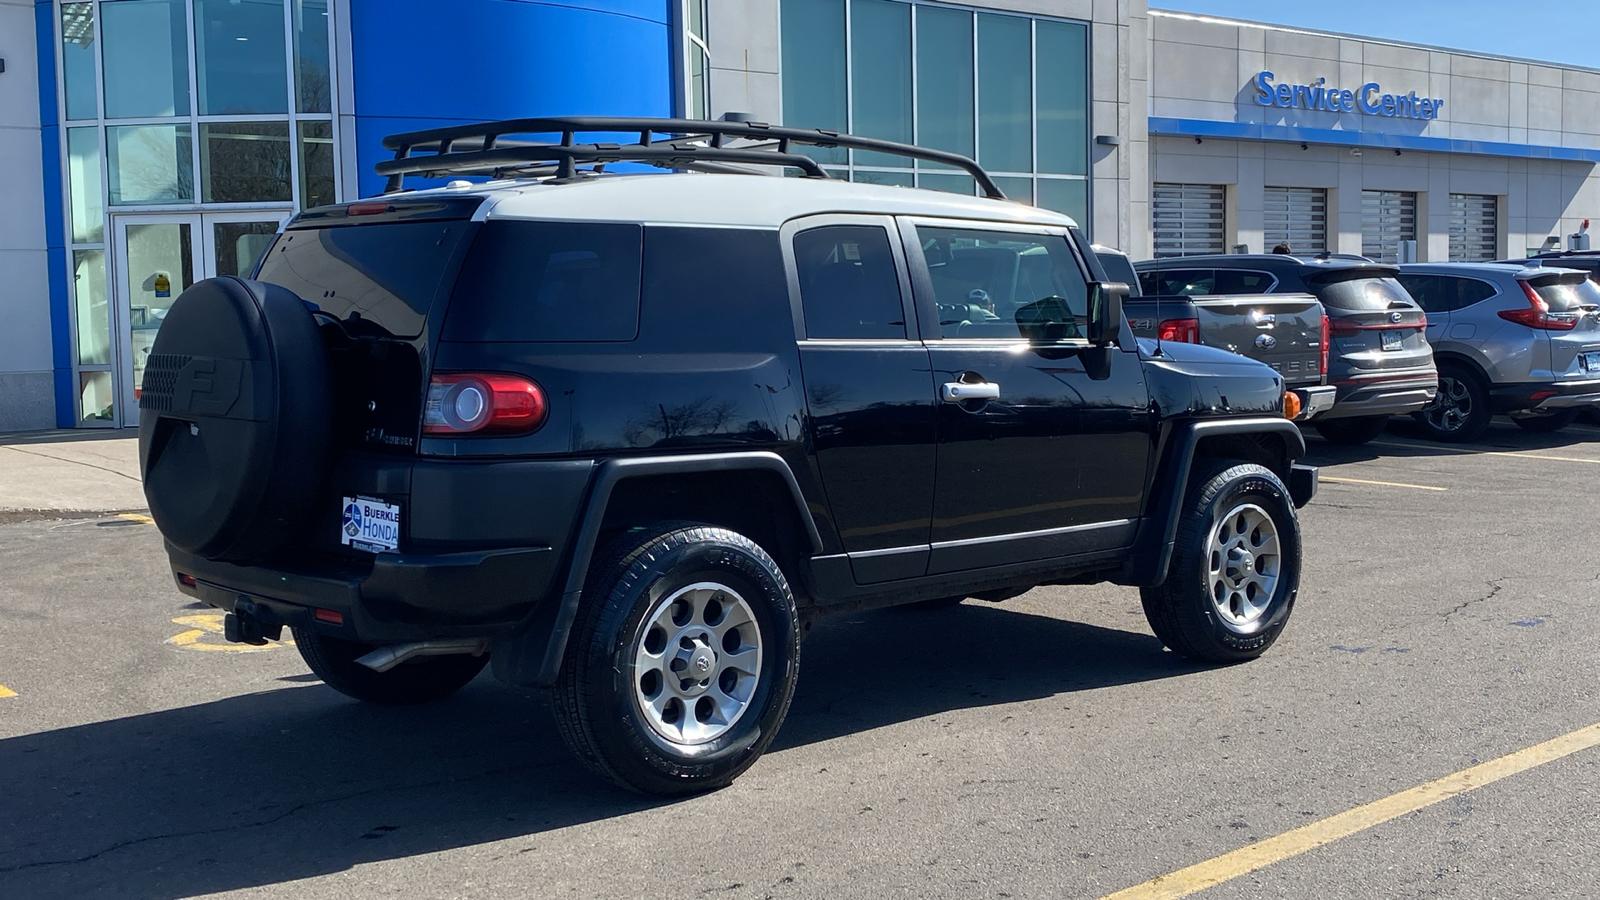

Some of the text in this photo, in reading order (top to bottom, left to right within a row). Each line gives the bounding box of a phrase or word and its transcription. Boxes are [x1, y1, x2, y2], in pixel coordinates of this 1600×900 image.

[1255, 70, 1444, 119] Service Center
[364, 505, 400, 522] BUERKLE
[362, 517, 398, 541] HONDA
